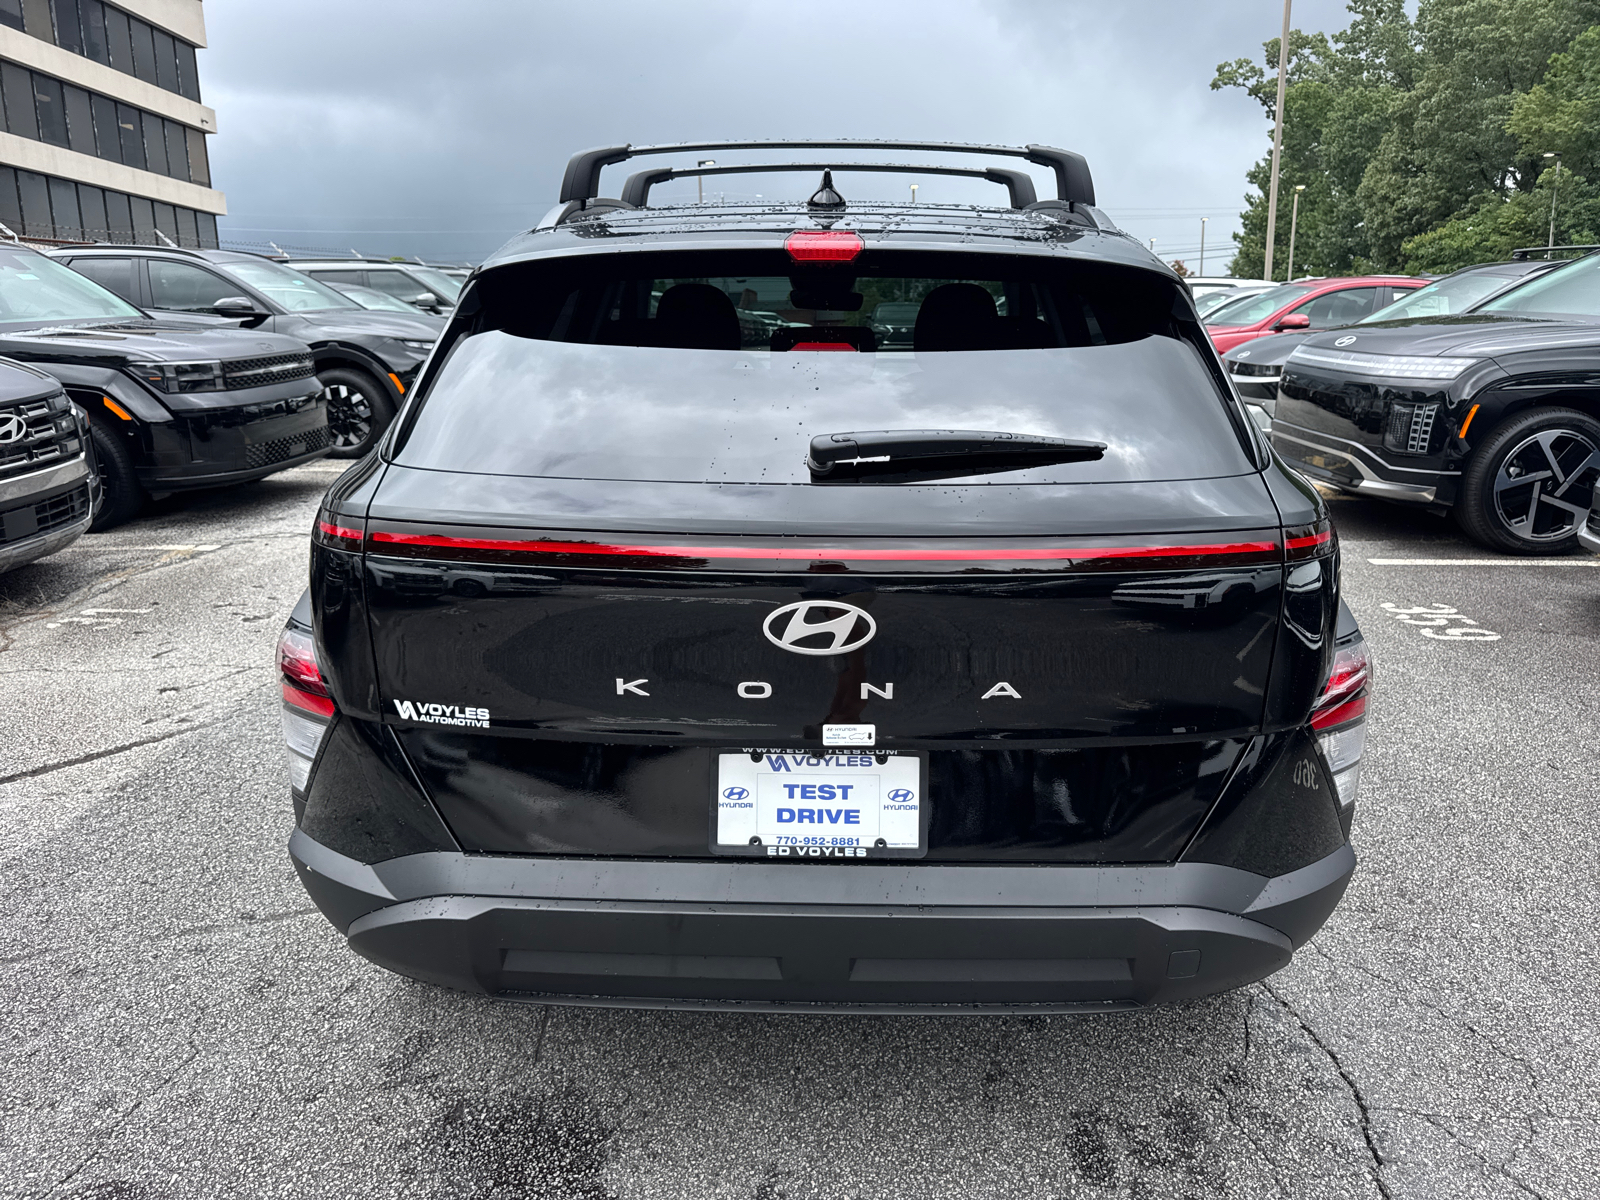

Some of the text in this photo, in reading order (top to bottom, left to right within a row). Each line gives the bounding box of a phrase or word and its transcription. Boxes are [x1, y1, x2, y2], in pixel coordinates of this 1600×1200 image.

[615, 677, 1022, 700] KONA
[416, 702, 490, 720] VOYLES
[419, 715, 490, 729] AUTOMOTIVE
[741, 747, 898, 756] WWW.EDLES.COM
[791, 755, 873, 767] VOYLES
[783, 784, 854, 800] TEST
[776, 808, 860, 825] DRIVE
[776, 836, 860, 846] 770-952-8881
[767, 846, 867, 857] ED VOYLES
